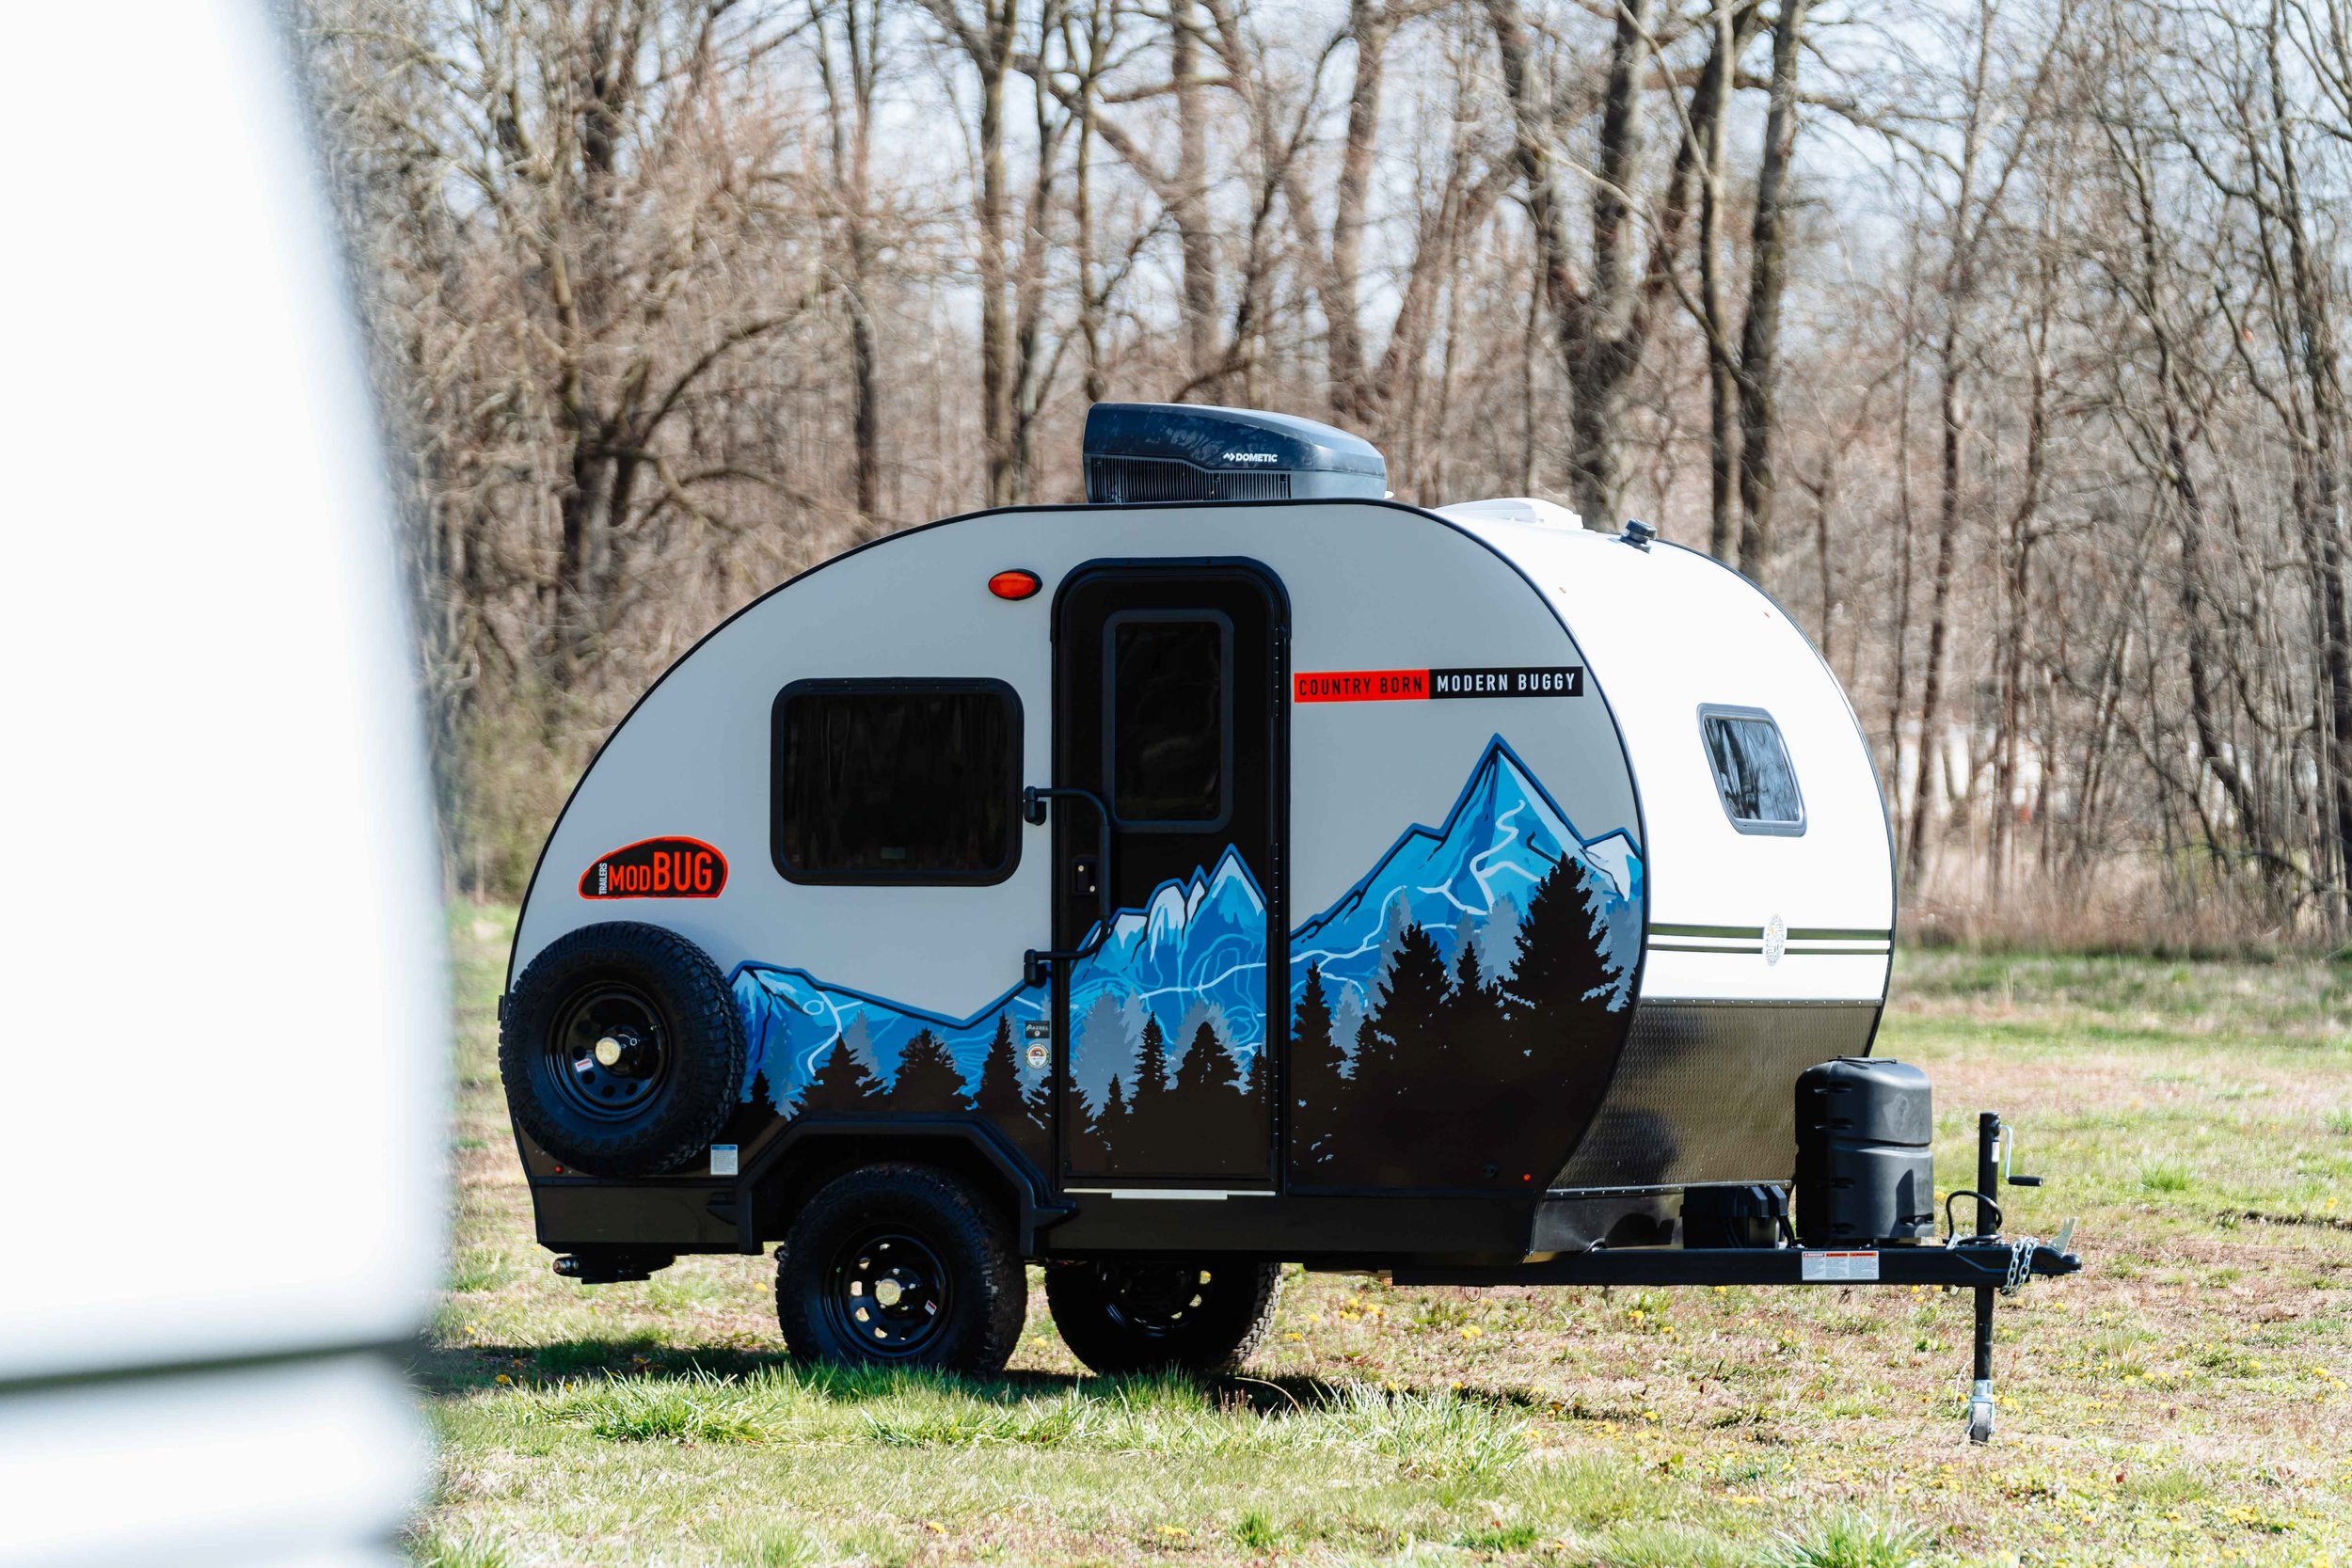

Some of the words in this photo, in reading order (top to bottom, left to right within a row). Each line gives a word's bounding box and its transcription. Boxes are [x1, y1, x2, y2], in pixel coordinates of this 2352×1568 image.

[1235, 452, 1278, 463] DOMETIC
[1299, 678, 1371, 696] COUNTRY
[1380, 676, 1422, 693] BORN
[1437, 674, 1508, 692] MODERN
[1518, 673, 1575, 690] BUGGY
[598, 863, 608, 895] TRAILERS
